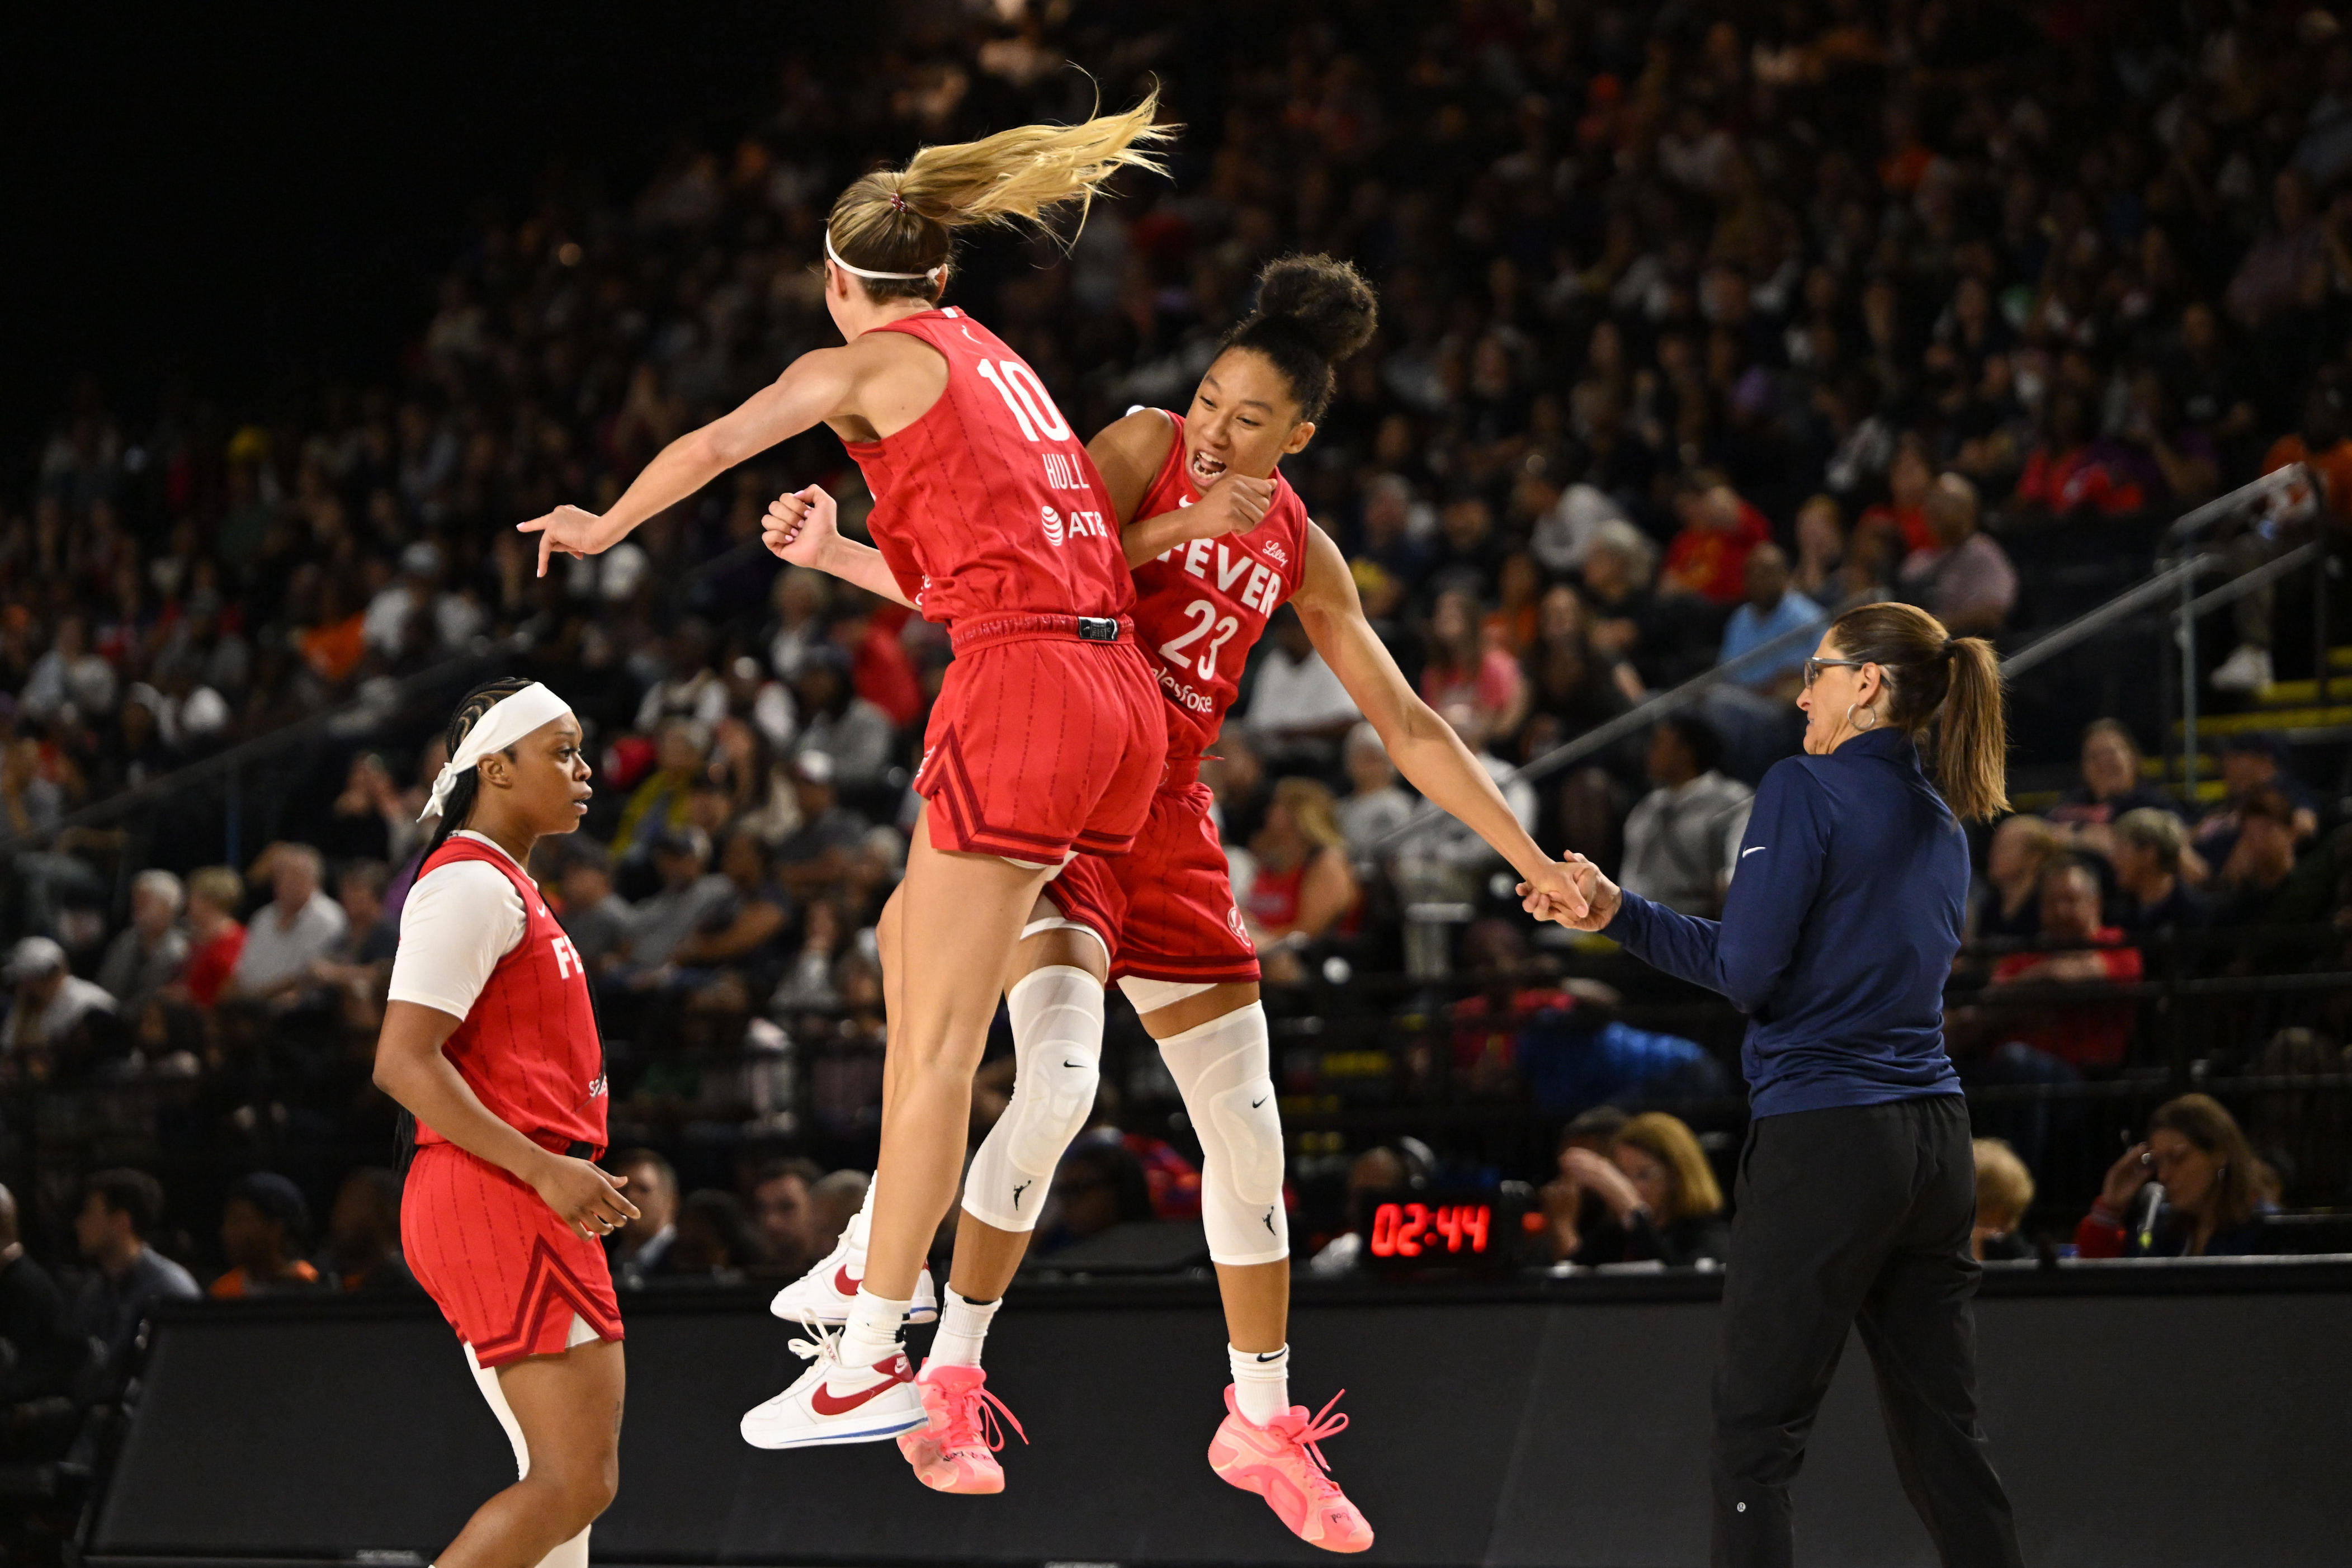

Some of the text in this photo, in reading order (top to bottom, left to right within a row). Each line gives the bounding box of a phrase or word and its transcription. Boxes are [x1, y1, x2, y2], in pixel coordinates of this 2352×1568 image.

[976, 358, 1070, 442] 10
[1041, 454, 1090, 490] HULL
[1262, 540, 1288, 568] Lilly
[1158, 599, 1239, 681] 23
[1371, 1202, 1491, 1257] 02:44
